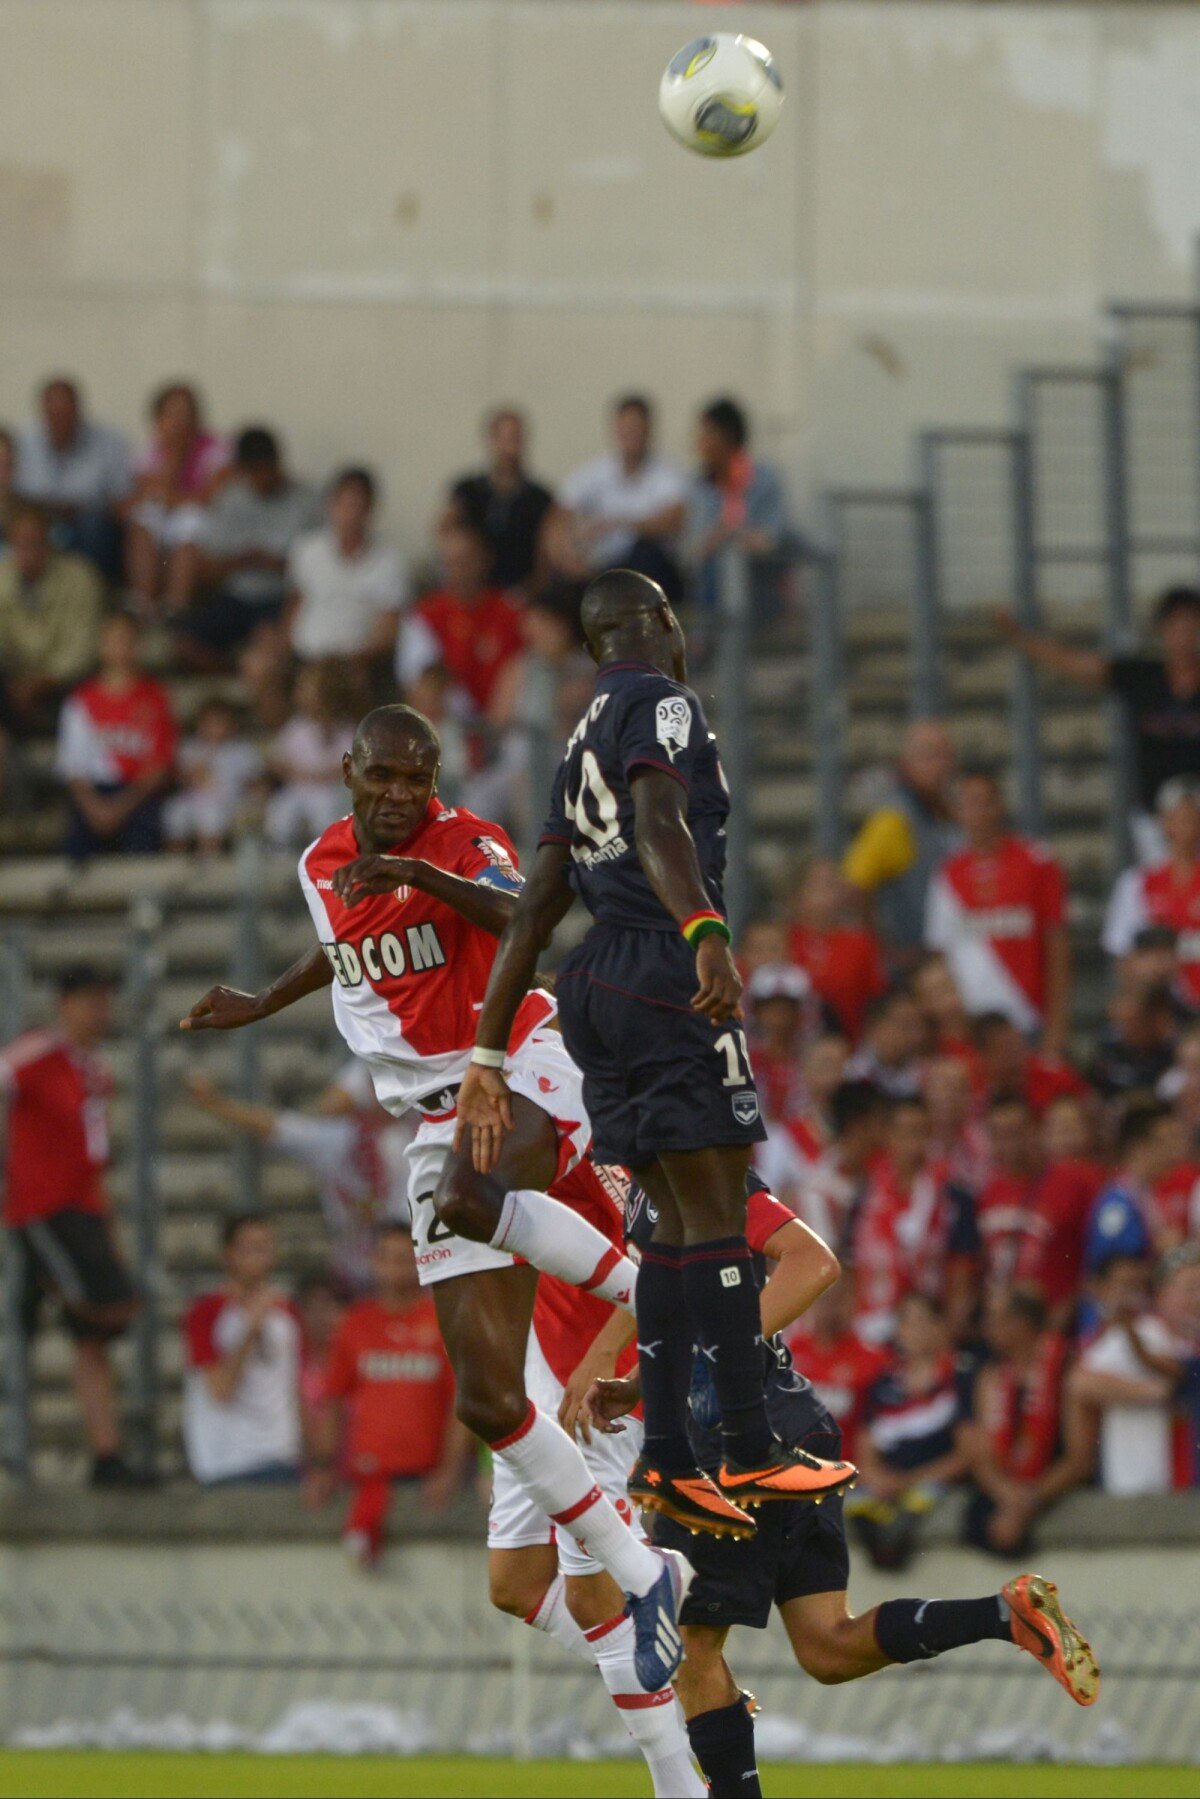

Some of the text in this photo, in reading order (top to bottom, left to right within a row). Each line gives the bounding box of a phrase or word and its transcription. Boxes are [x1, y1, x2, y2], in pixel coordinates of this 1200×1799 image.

[321, 919, 447, 988] EDCOM
[408, 1190, 456, 1247] 2
[415, 1248, 451, 1266] cron
[723, 1270, 738, 1284] 10
